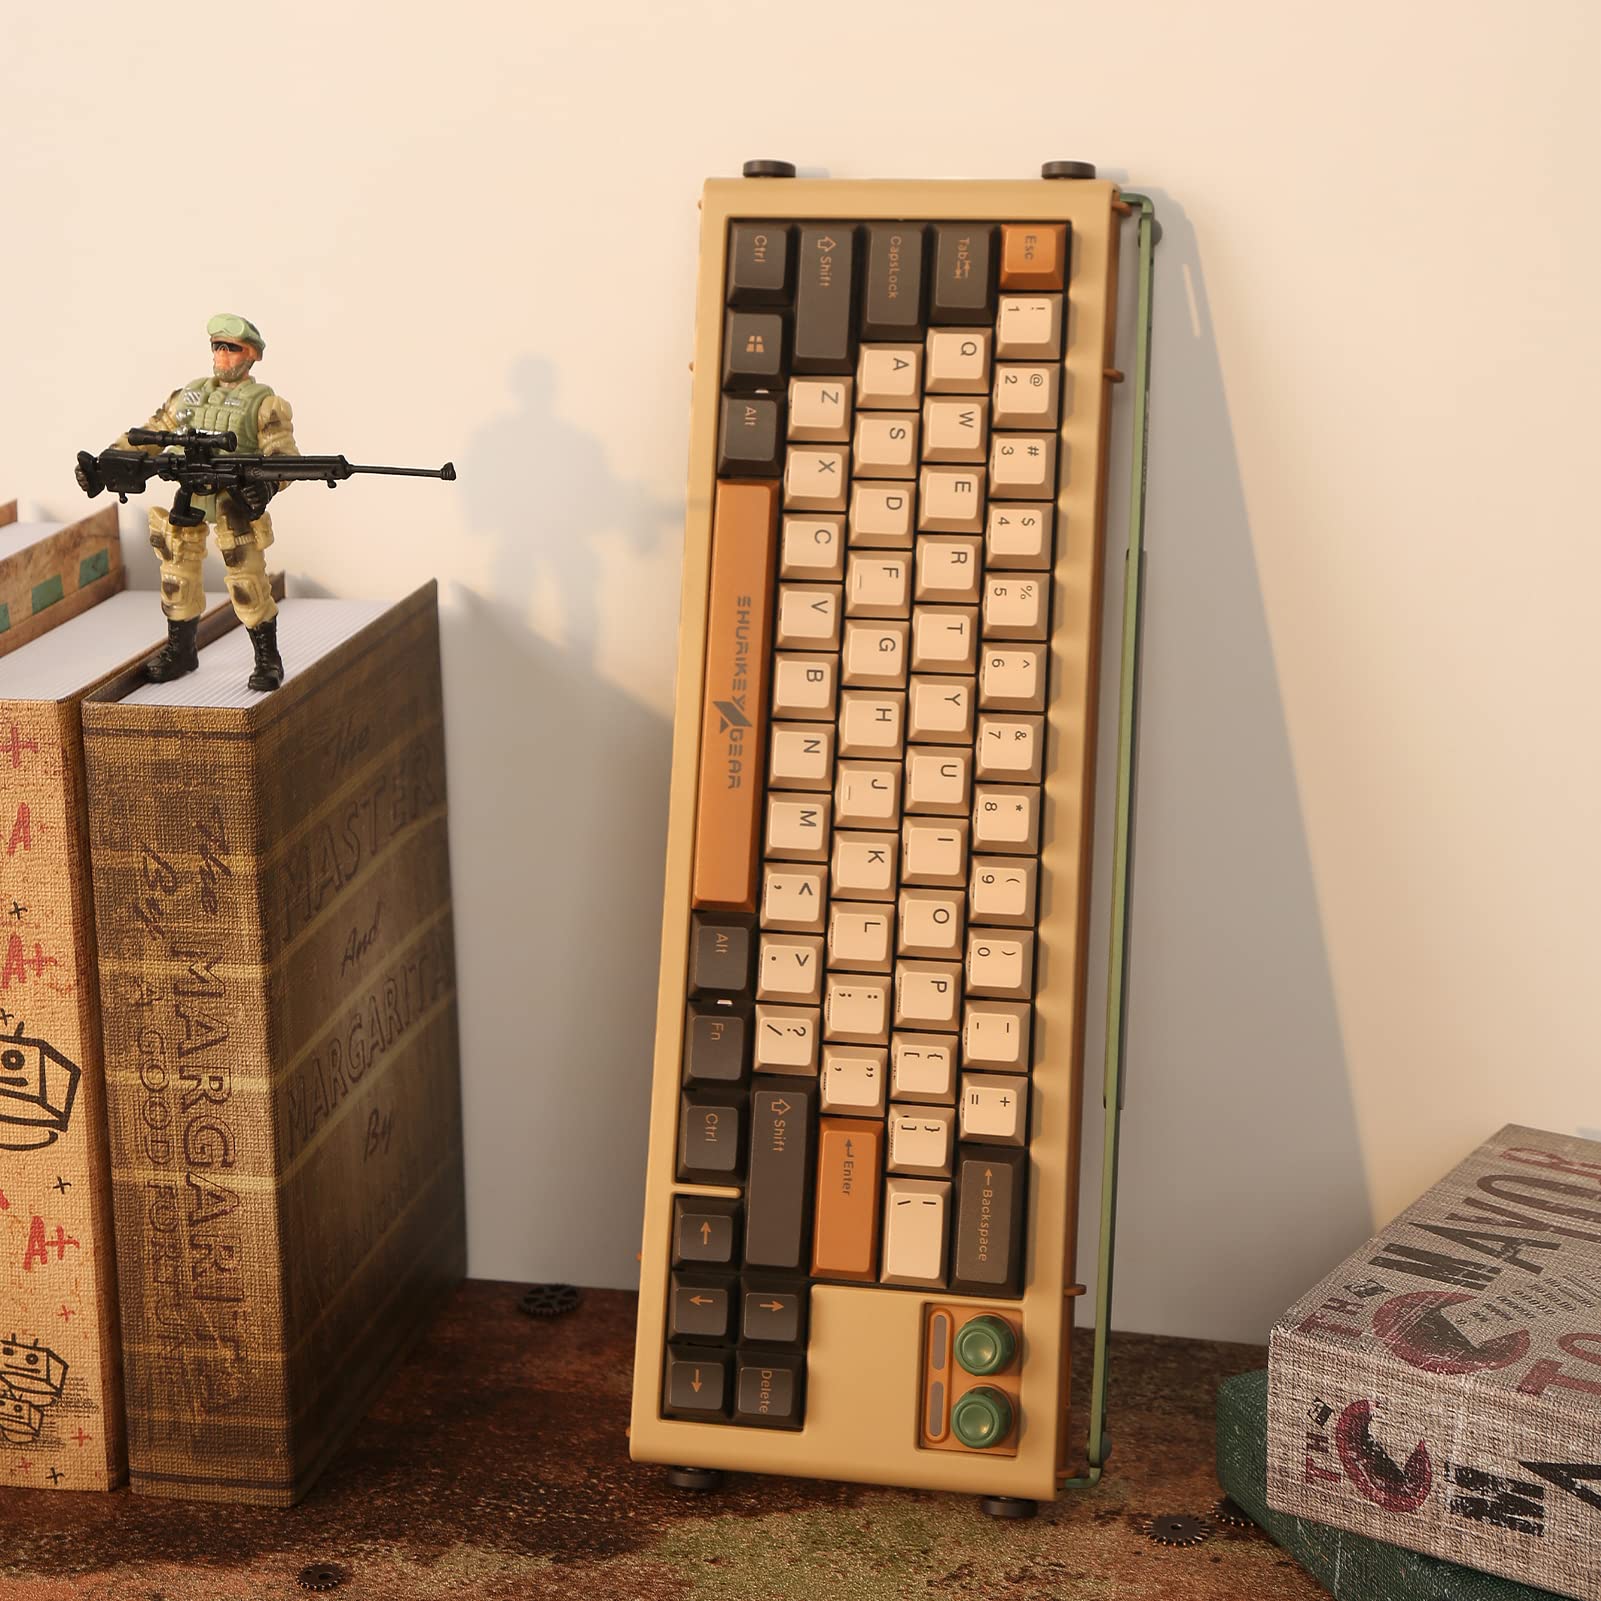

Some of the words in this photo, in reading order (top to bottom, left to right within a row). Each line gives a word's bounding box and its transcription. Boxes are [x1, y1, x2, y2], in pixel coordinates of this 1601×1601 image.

[754, 235, 767, 262] Ctrl
[958, 237, 970, 259] Tab
[1024, 235, 1037, 260] Esc
[820, 256, 831, 286] Shift
[888, 236, 901, 298] CapsLock
[961, 342, 977, 356] Q
[893, 358, 909, 370] A
[1005, 376, 1017, 384] 2
[821, 390, 839, 404] Z
[745, 407, 756, 425] Alt
[959, 411, 974, 428] W
[890, 428, 905, 439] S
[1001, 446, 1014, 455] 3
[819, 460, 835, 472] X
[955, 481, 971, 492] E
[886, 497, 902, 510] D
[998, 517, 1010, 525] 4
[815, 530, 831, 544] C
[951, 552, 967, 564] R
[883, 568, 898, 578] F
[994, 588, 1007, 596] 5
[811, 600, 828, 613] V
[947, 623, 963, 634] T
[879, 638, 895, 651] G
[992, 659, 1004, 667] 6
[807, 670, 824, 682] B
[945, 694, 960, 706] Y
[876, 708, 892, 721] H
[989, 731, 1001, 739] 7
[804, 740, 820, 753] N
[727, 727, 744, 790] GEAR
[941, 765, 957, 777] U
[872, 779, 887, 789] J
[985, 802, 997, 811] 8
[800, 811, 817, 826] M
[281, 742, 440, 943] MASTER
[868, 851, 885, 863] K
[982, 875, 994, 884] 9
[933, 909, 949, 924] O
[865, 922, 880, 932] L
[716, 934, 728, 952] Alt
[978, 947, 990, 956] 0
[931, 981, 947, 993] P
[711, 1023, 723, 1040] Fn
[136, 1028, 175, 1165] GOOD
[705, 1114, 718, 1141] Ctrl
[773, 1120, 786, 1151] Shift
[166, 940, 247, 1418] MARGARITA
[842, 1161, 854, 1196] Enter
[978, 1190, 992, 1261] Backspace
[23, 1215, 80, 1271] A+
[758, 1371, 772, 1414] Delete
